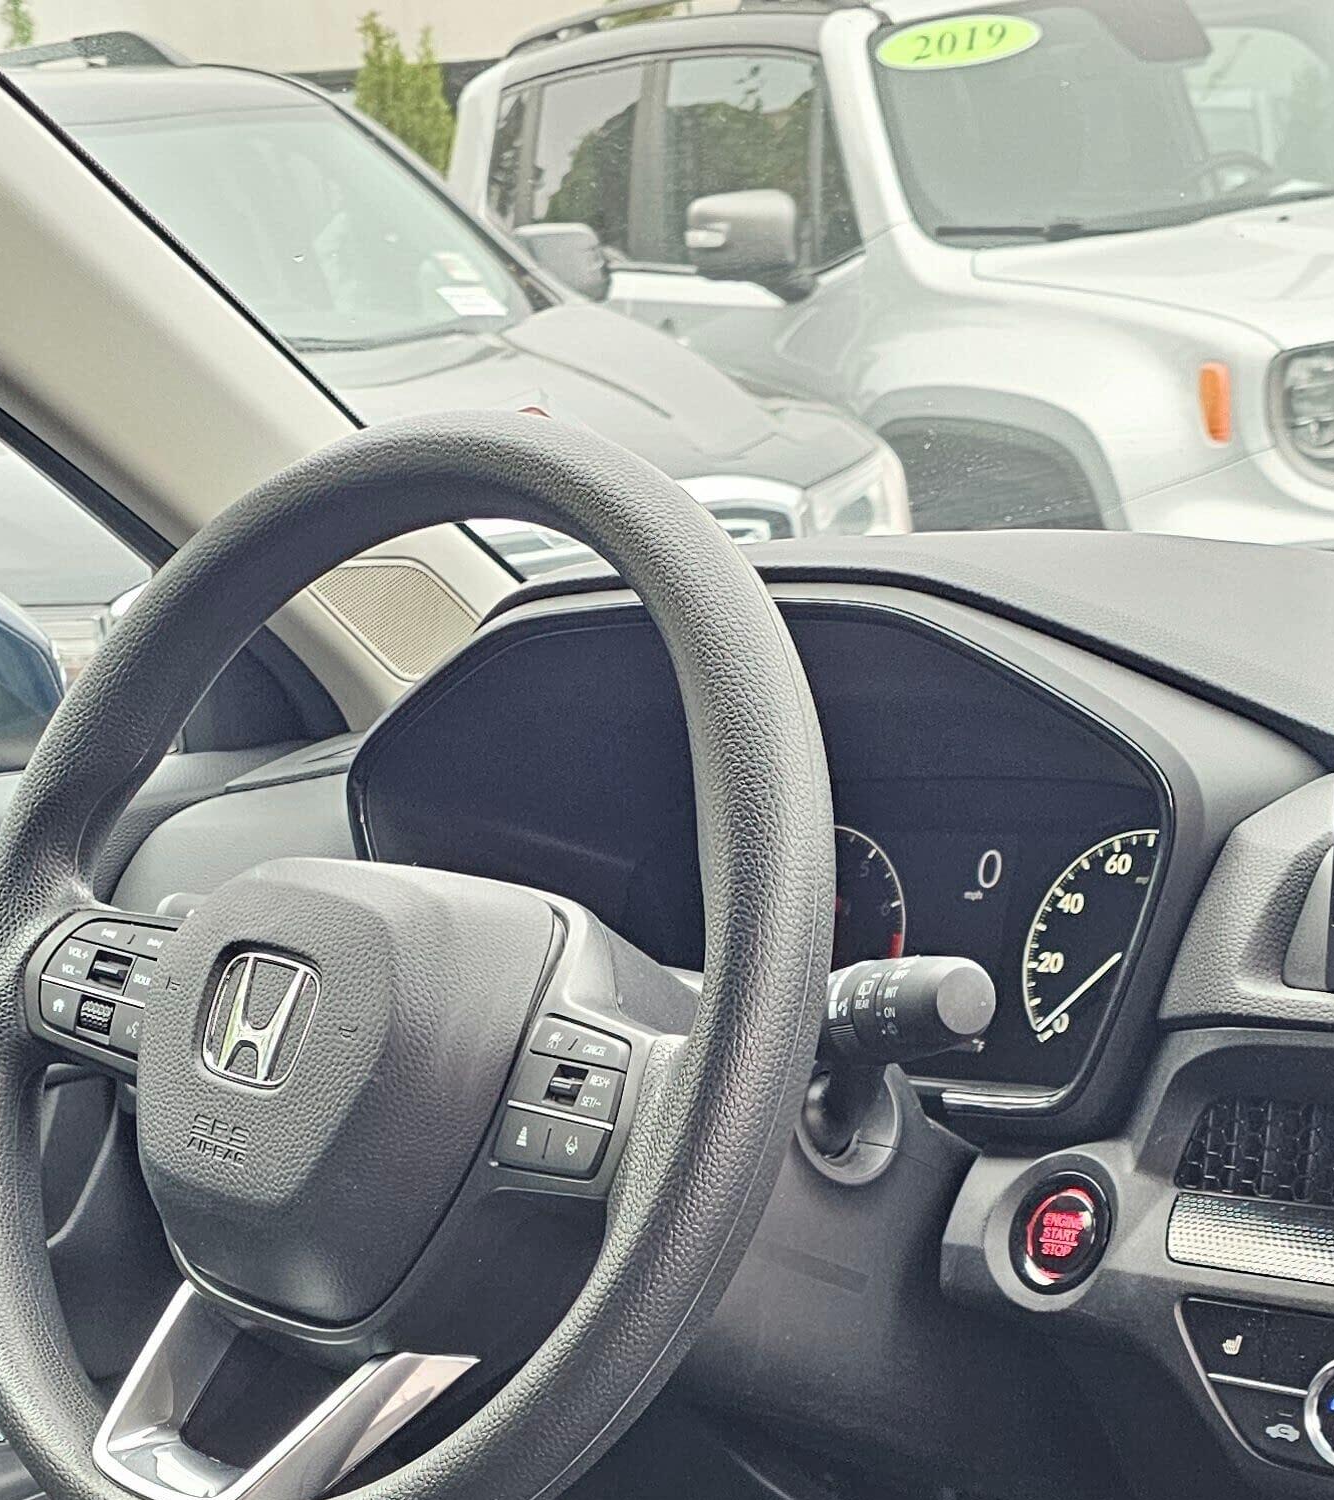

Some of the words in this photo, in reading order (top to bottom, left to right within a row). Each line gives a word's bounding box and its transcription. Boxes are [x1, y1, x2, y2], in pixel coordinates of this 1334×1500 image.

[913, 22, 1008, 62] 2019
[978, 849, 1002, 889] 0
[1104, 853, 1133, 875] 60
[1056, 892, 1085, 915] 40
[1036, 951, 1065, 974] 20
[883, 1006, 896, 1018] ON
[1051, 1011, 1070, 1034] 0
[191, 1113, 251, 1144] SRS
[1043, 1212, 1085, 1231] ENGINE
[1043, 1227, 1080, 1242] START
[1041, 1243, 1073, 1257] STOP
